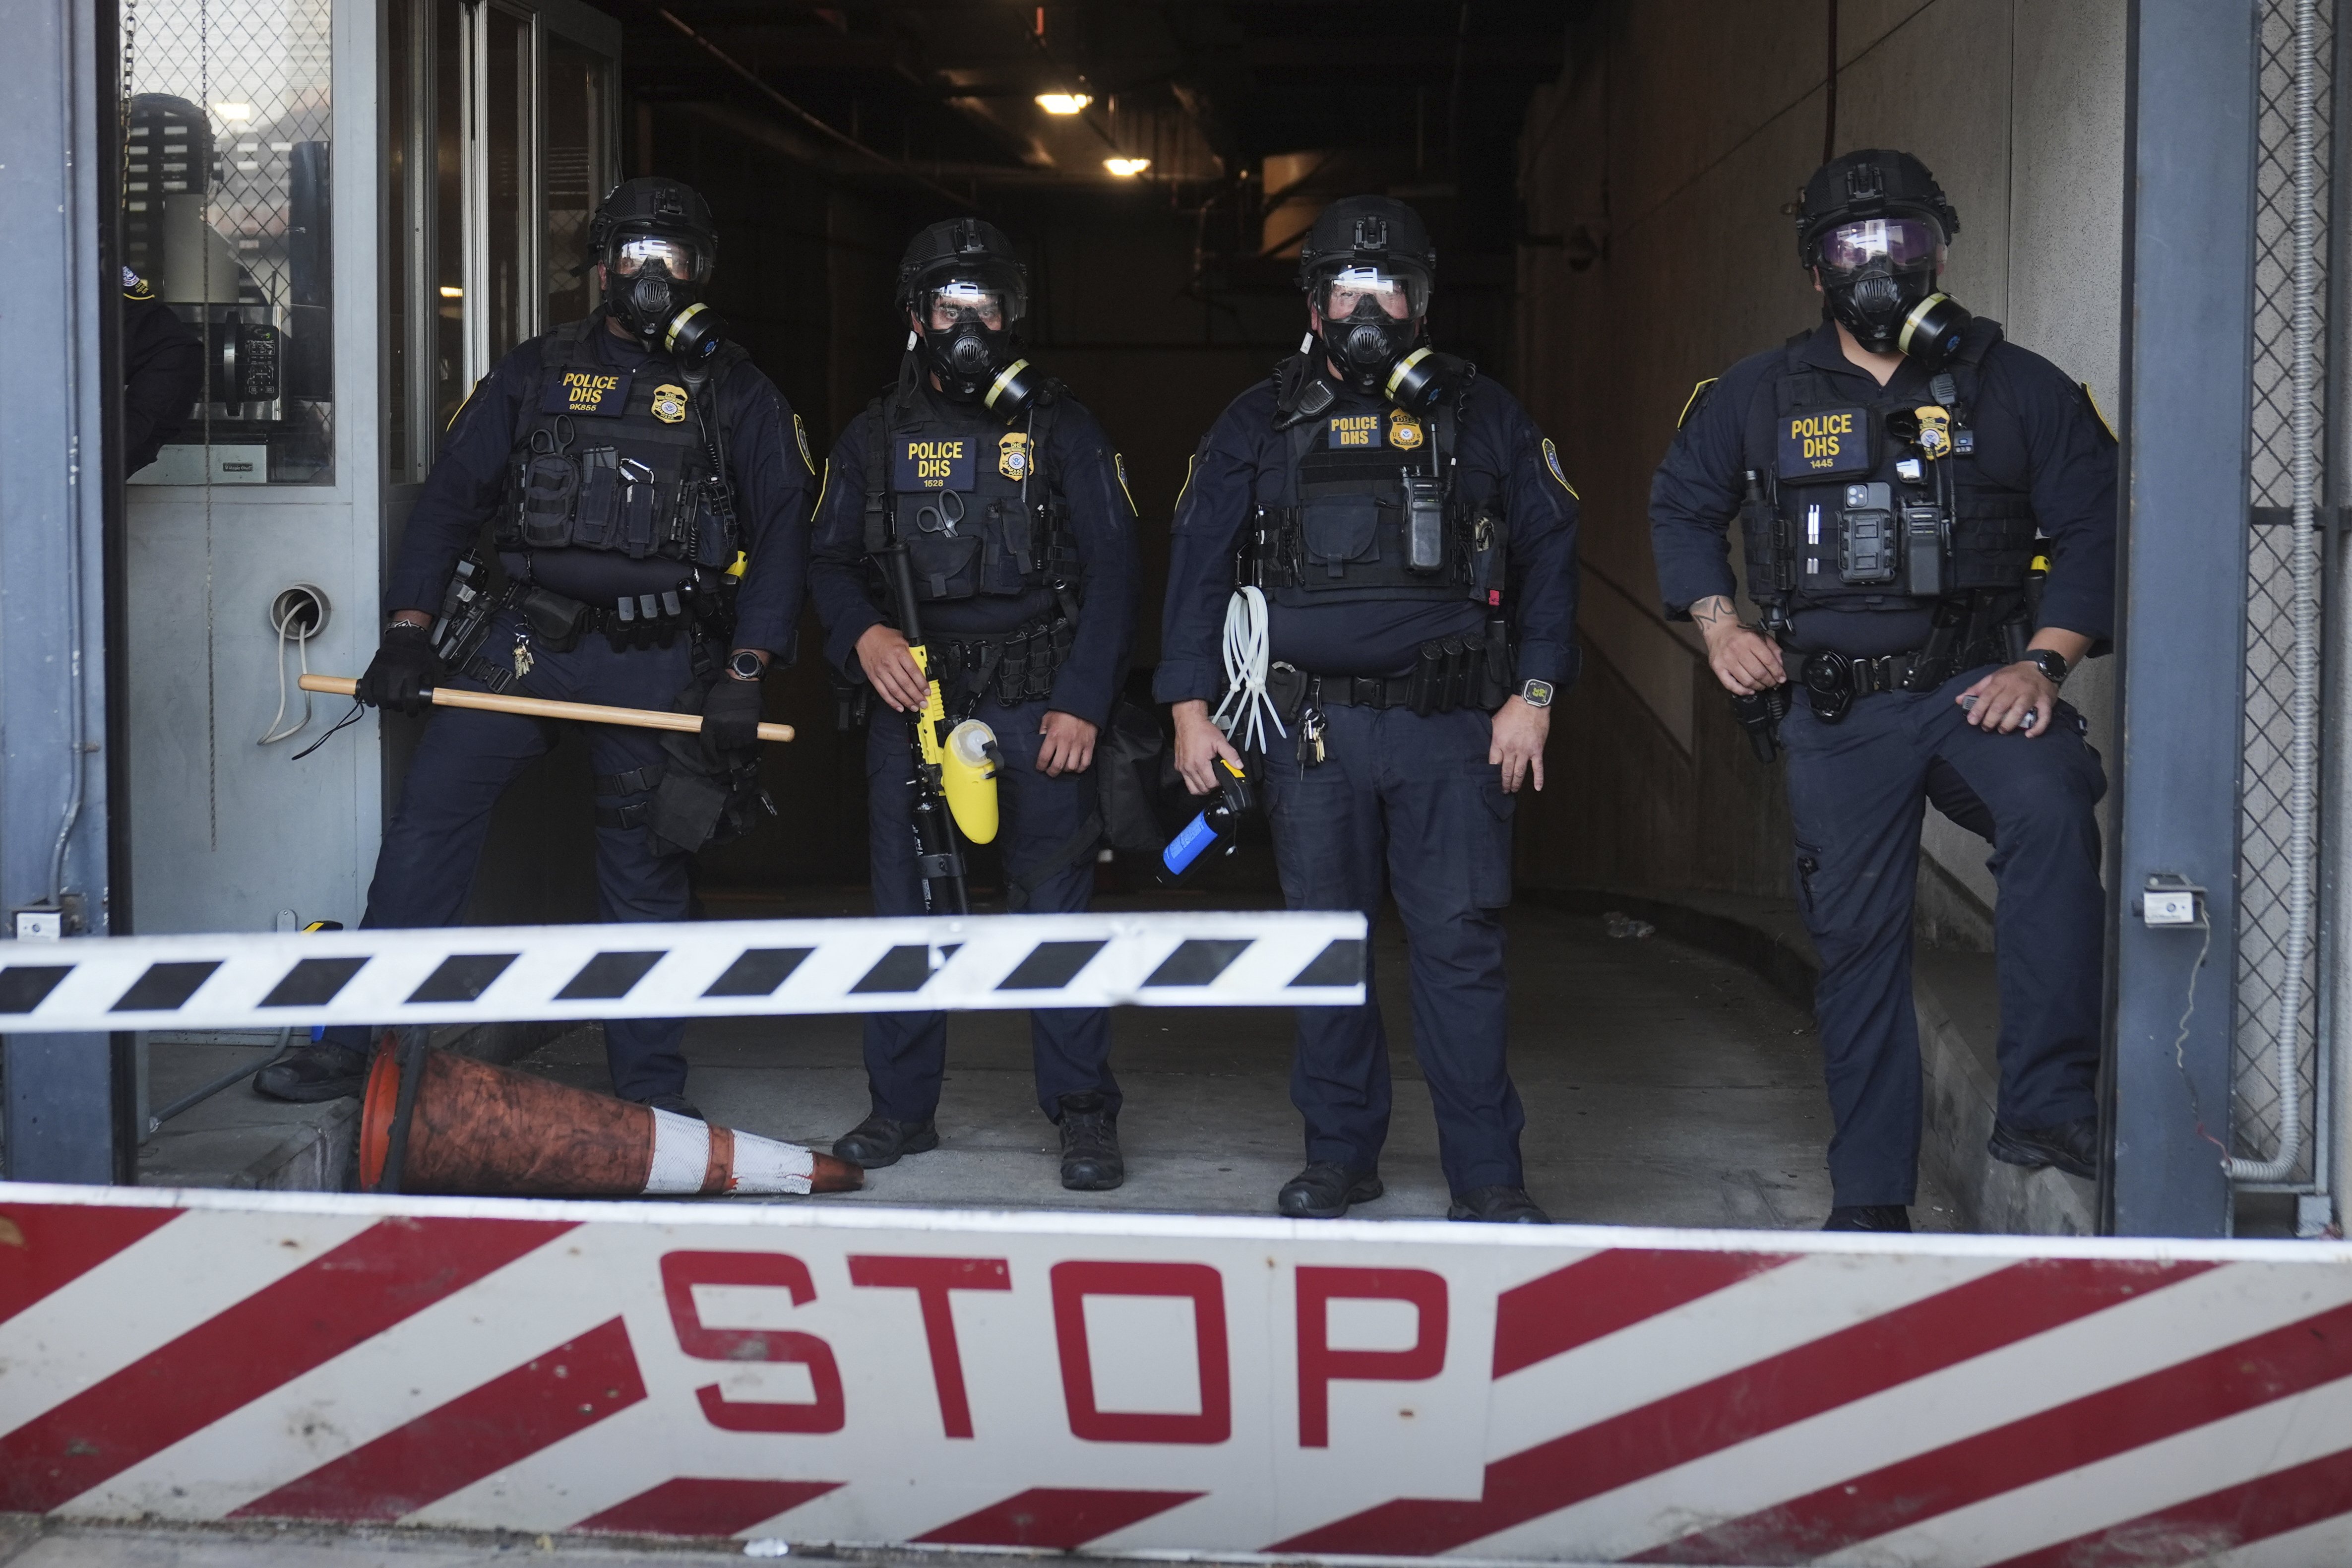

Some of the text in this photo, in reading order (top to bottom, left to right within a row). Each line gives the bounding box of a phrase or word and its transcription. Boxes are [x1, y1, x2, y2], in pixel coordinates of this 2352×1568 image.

[562, 373, 619, 390] POLICE
[569, 387, 603, 403] DHS
[1331, 416, 1377, 432] POLICE
[1792, 414, 1852, 439] POLICE
[1341, 431, 1369, 445] DHS
[908, 441, 963, 460] POLICE
[1803, 436, 1840, 458] DHS
[919, 459, 951, 477] DHS
[1810, 458, 1834, 469] 1445
[660, 1250, 1448, 1448] STOP
